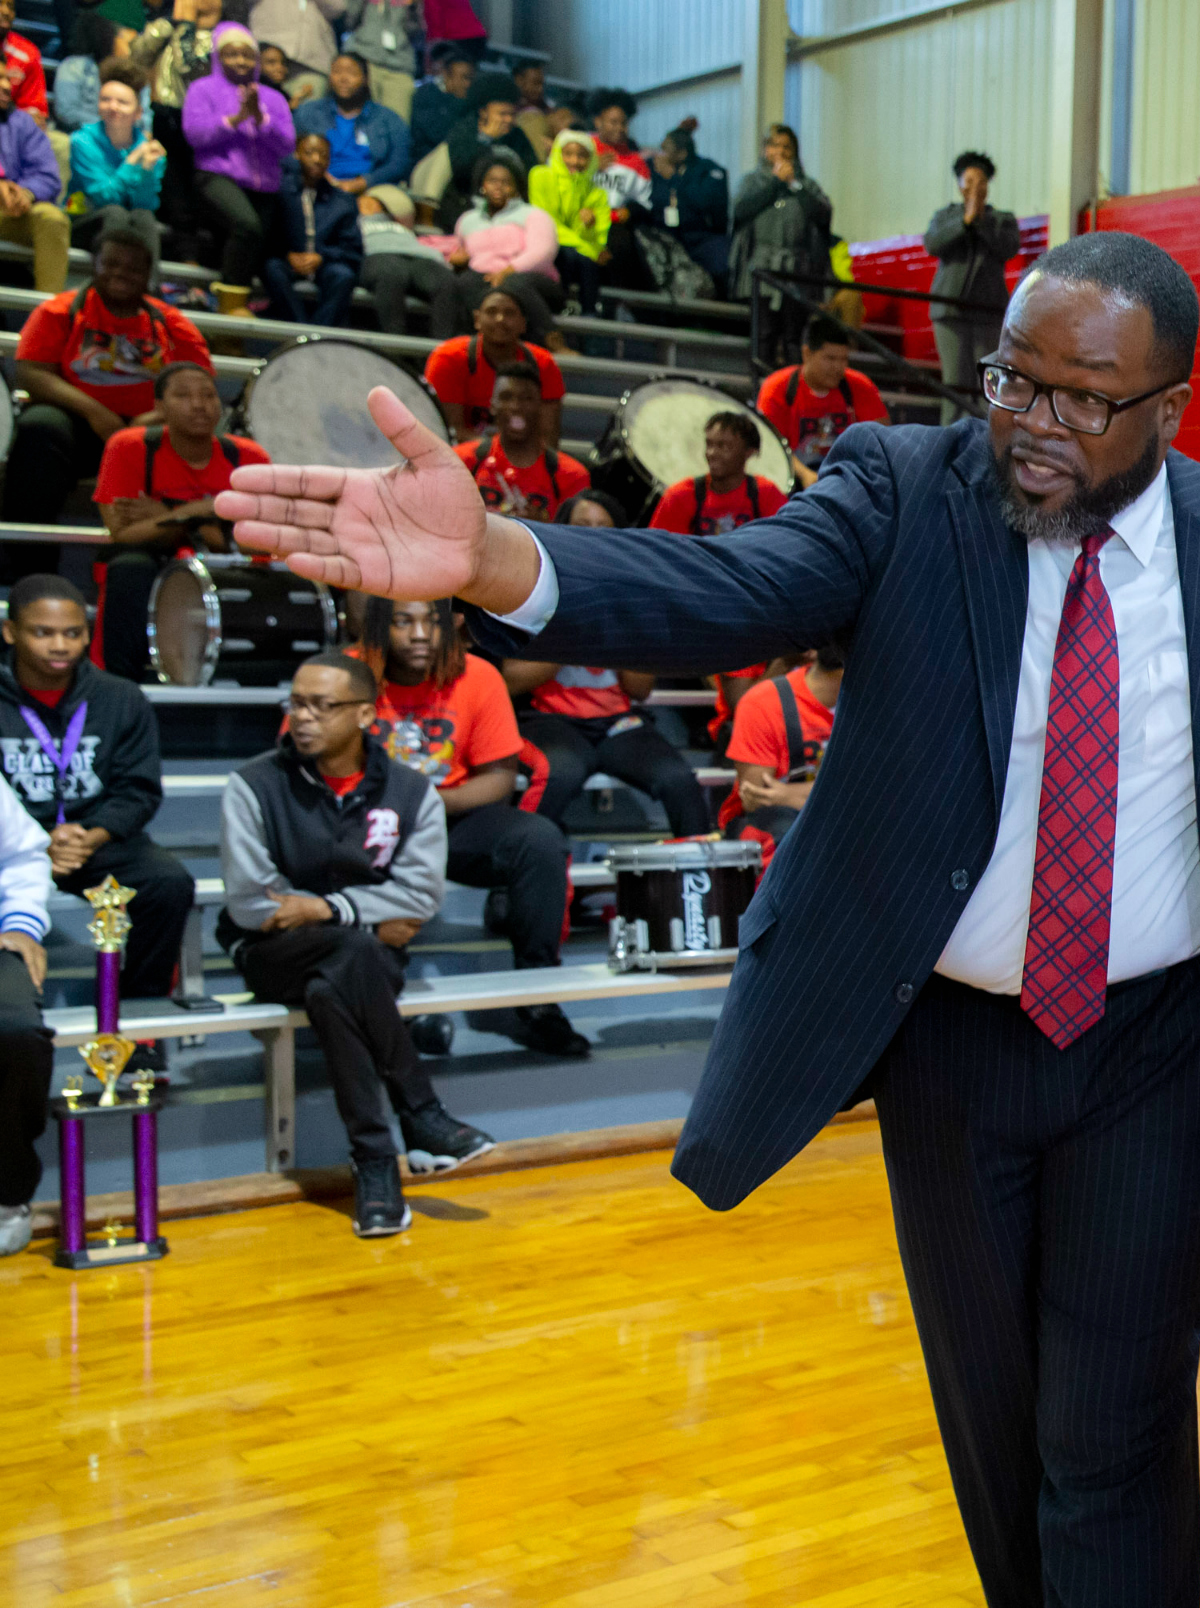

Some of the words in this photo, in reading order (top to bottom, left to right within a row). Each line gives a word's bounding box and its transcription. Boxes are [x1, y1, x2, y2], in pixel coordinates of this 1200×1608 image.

[3, 751, 56, 774] CLAS
[70, 751, 96, 772] OF
[681, 870, 712, 950] Dynasty
